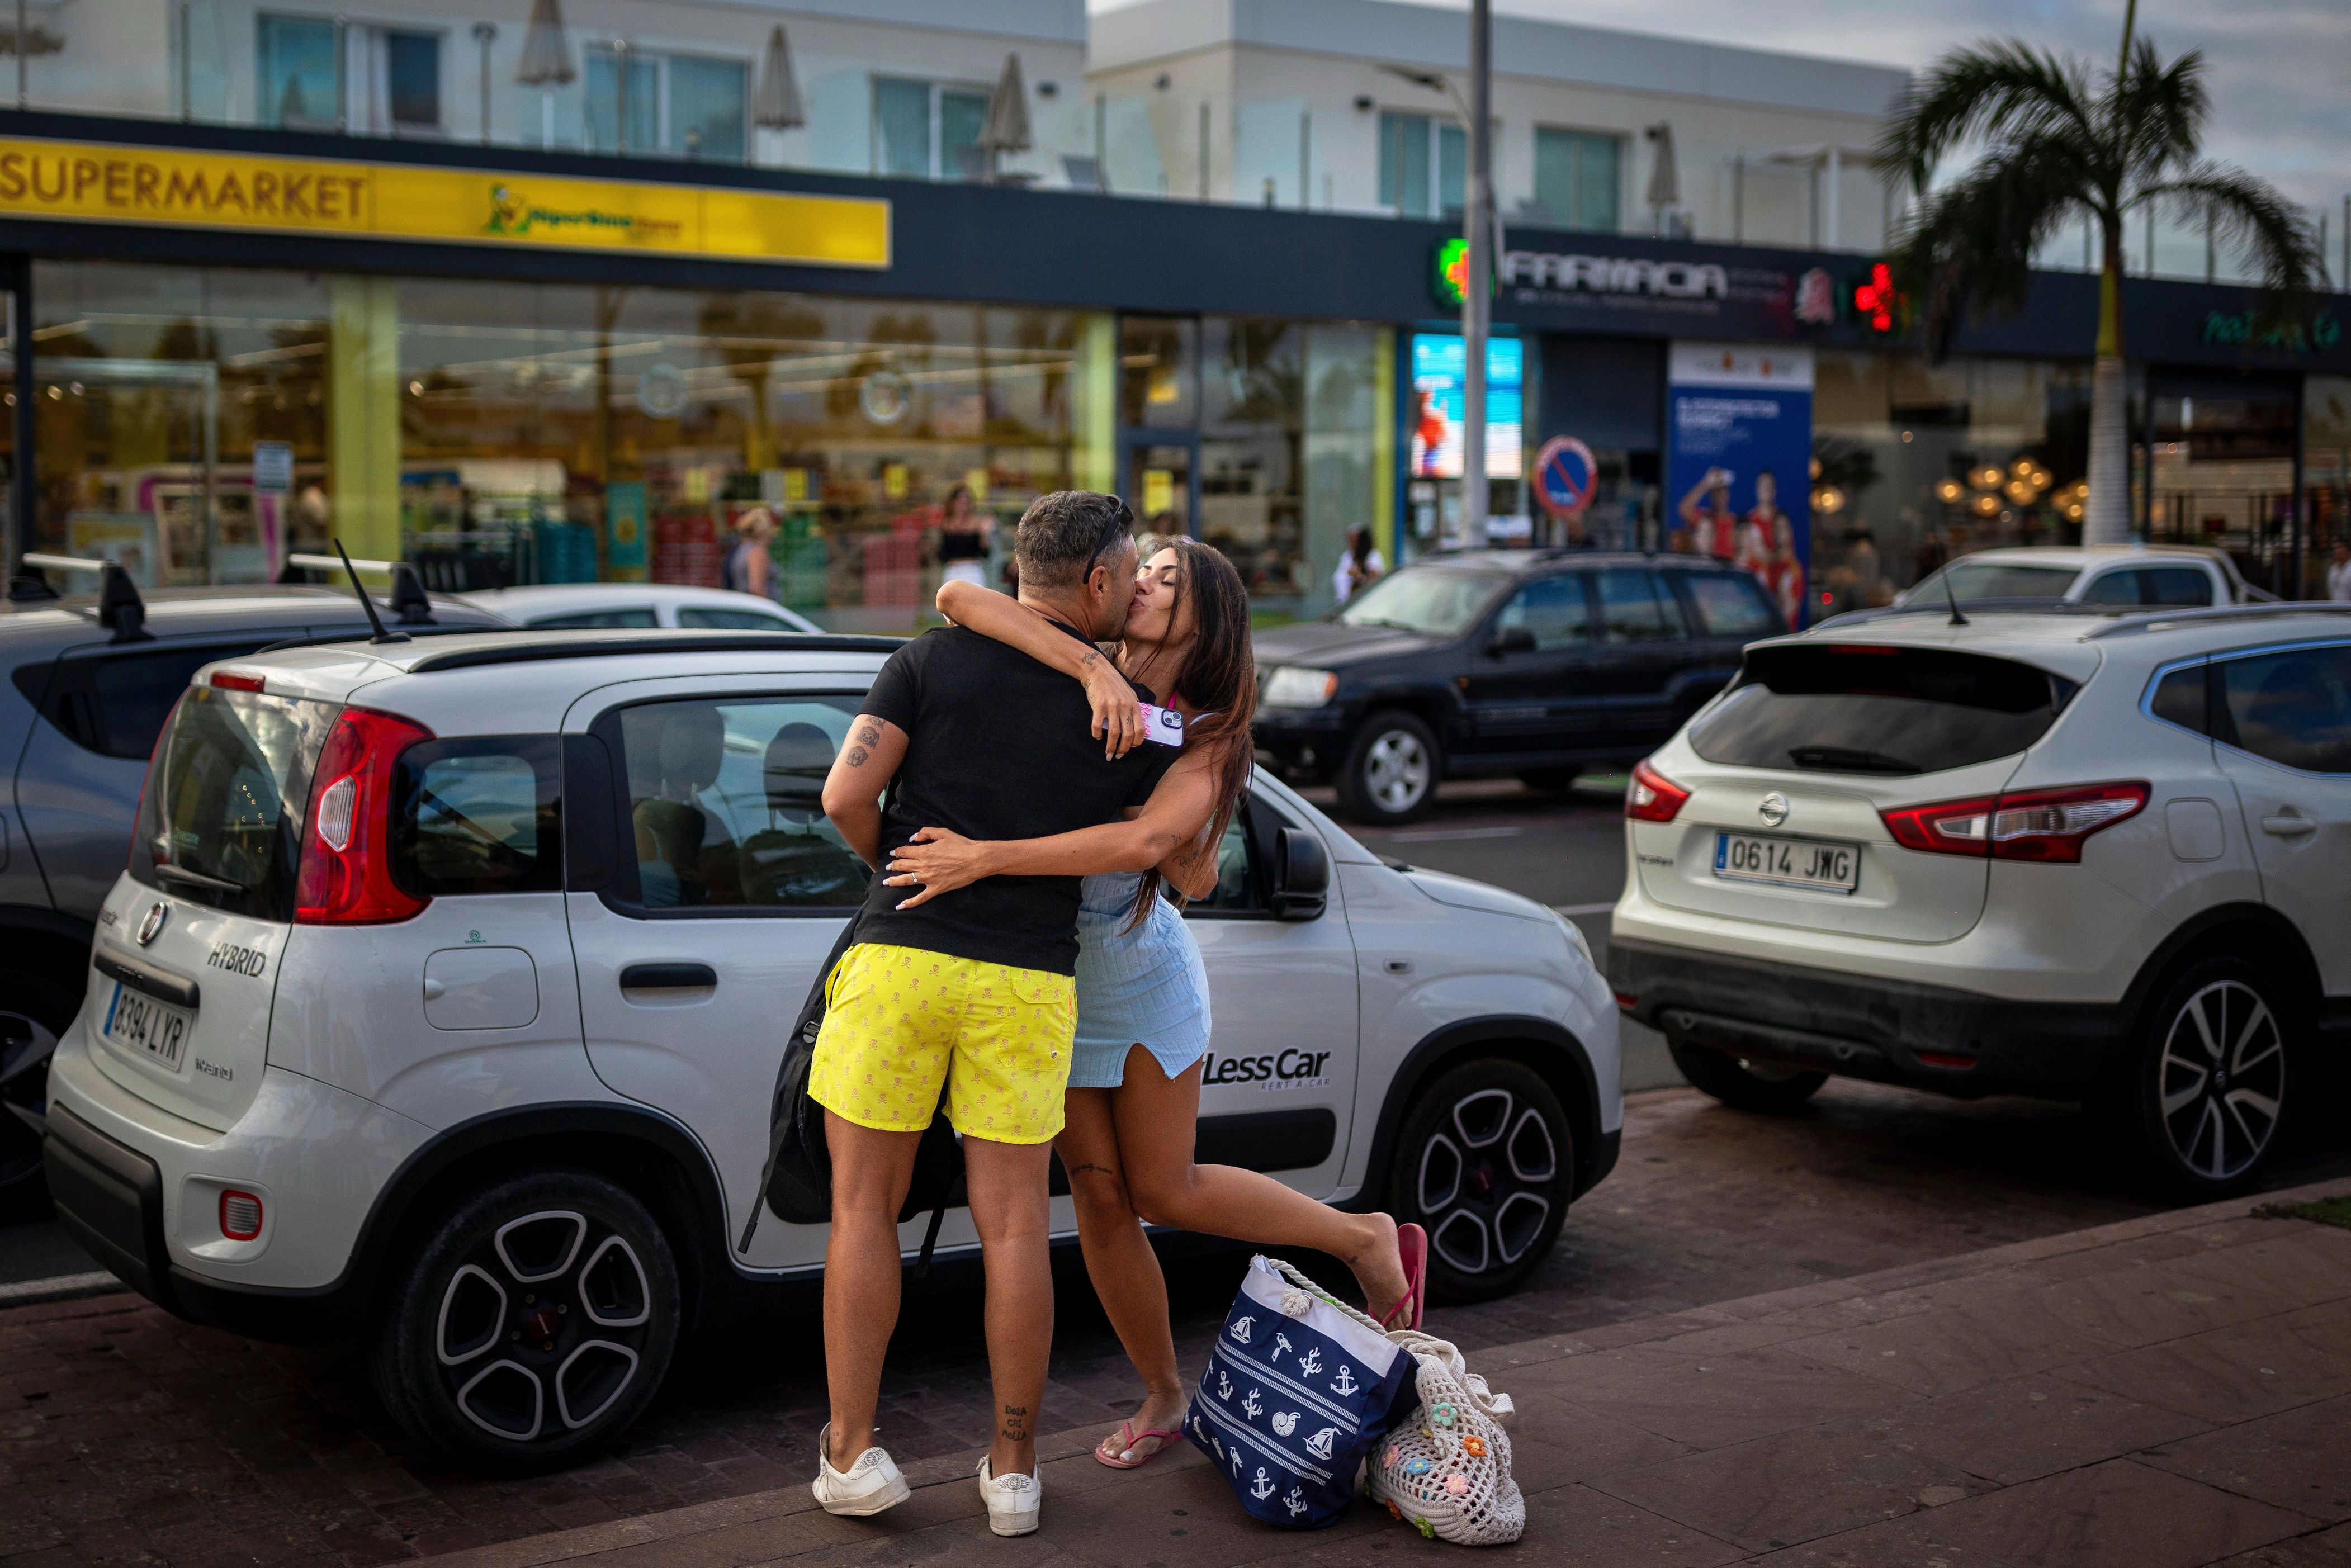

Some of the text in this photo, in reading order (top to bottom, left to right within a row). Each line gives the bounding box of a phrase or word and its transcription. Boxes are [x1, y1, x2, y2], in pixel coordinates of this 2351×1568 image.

[0, 152, 367, 221] SUPERMARKET
[1732, 840, 1848, 880] 0614 JWG
[207, 941, 267, 977] HYBRID
[114, 993, 183, 1060] 8394 LYR
[1202, 1048, 1332, 1086] LessCar
[1261, 1081, 1292, 1091] RENT
[1309, 1077, 1331, 1088] CAR
